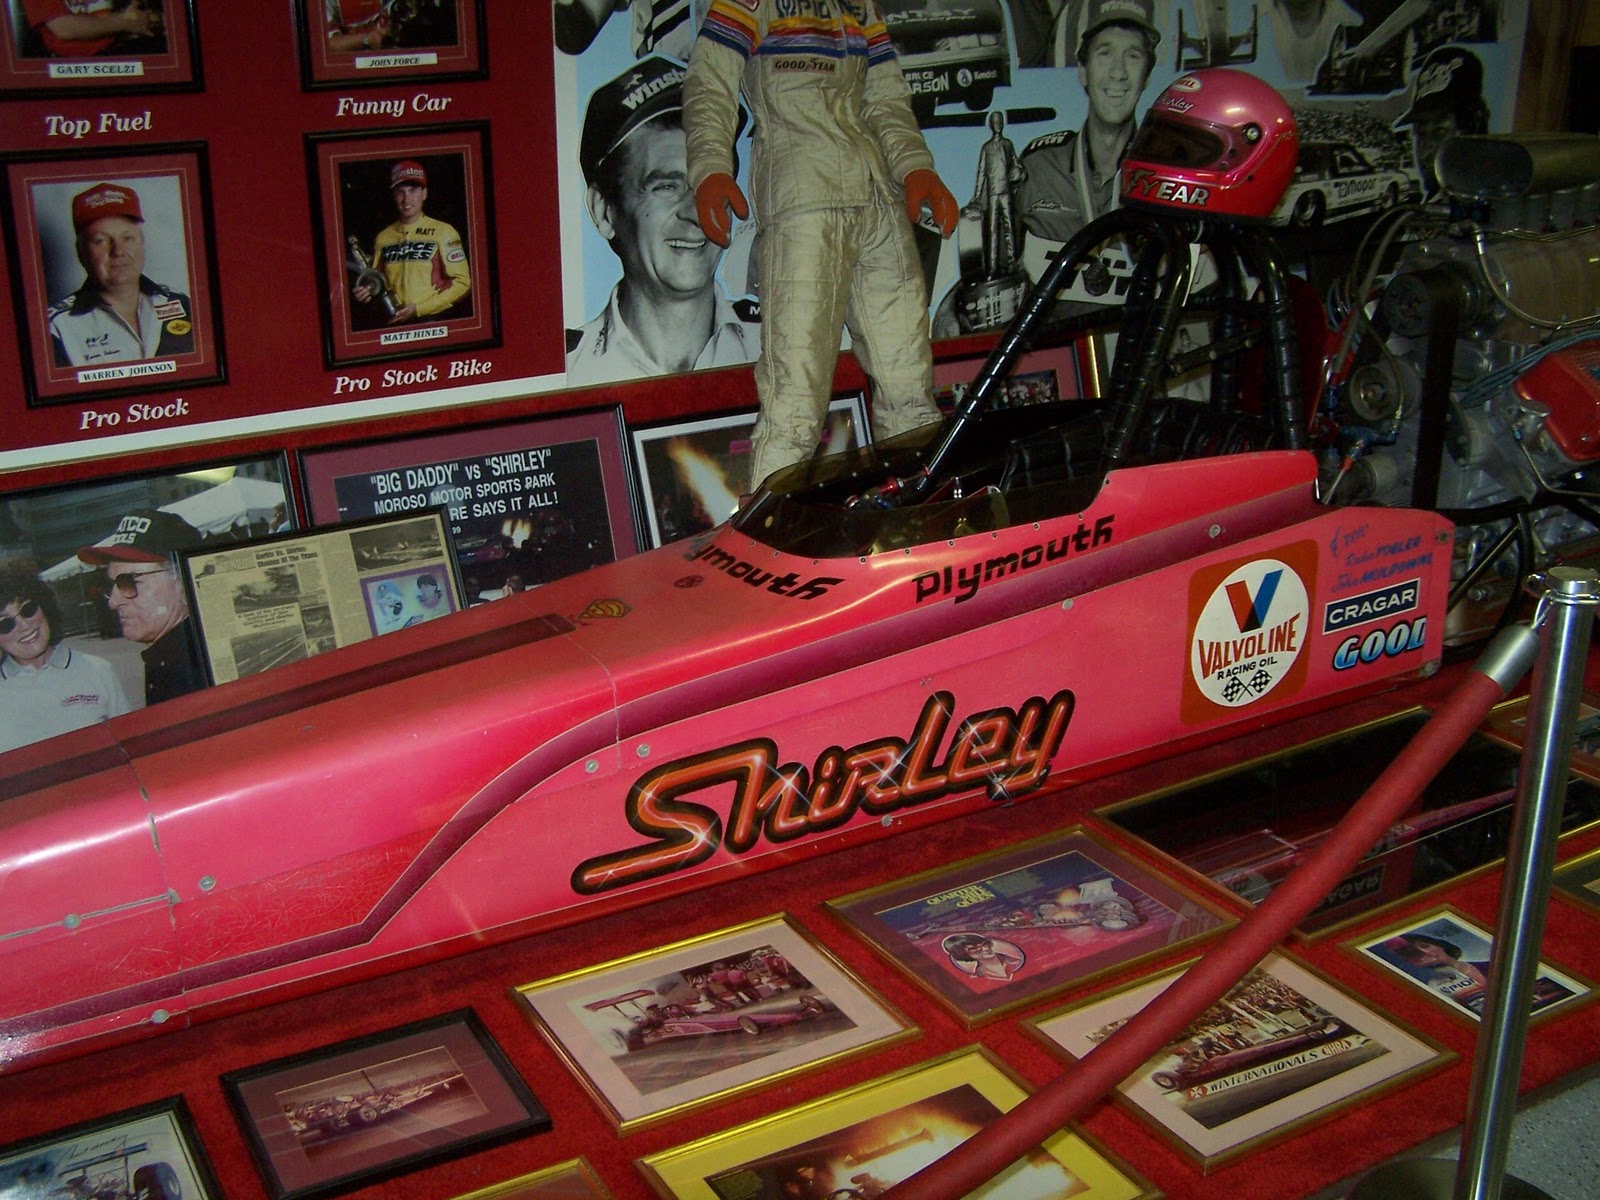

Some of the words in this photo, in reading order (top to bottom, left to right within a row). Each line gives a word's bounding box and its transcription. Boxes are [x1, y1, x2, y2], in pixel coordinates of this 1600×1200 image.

[57, 65, 90, 74] GARY
[94, 65, 136, 74] SCELZI
[370, 58, 391, 67] JOHN
[393, 57, 420, 65] FORCE
[336, 97, 406, 118] Funny
[412, 93, 452, 112] Car
[46, 115, 91, 139] Top
[98, 111, 152, 133] Fuel
[383, 332, 412, 343] MATT
[413, 327, 445, 339] HINES
[83, 368, 125, 381] WARREN
[129, 363, 174, 377] JOHNSON
[333, 376, 371, 395] Pro
[382, 364, 439, 388] Stock
[448, 358, 492, 379] Bike
[80, 410, 121, 430] Pro
[127, 398, 189, 423] Stock
[370, 474, 401, 495] "BIG
[406, 463, 459, 490] DADDY"
[485, 448, 552, 477] "SHIRLEY"
[374, 494, 427, 515] MOROSO
[431, 486, 472, 505] MOTOR
[476, 478, 522, 498] SPORTS
[525, 473, 556, 491] PARK
[473, 499, 507, 518] SAYS
[510, 496, 523, 512] IT
[528, 491, 559, 509] ALL!
[911, 514, 1115, 604] Plymouth
[1328, 588, 1416, 625] CRAGAR
[1198, 612, 1301, 680] VALVOLINE
[1217, 661, 1257, 681] RACING
[1258, 655, 1278, 668] OIL
